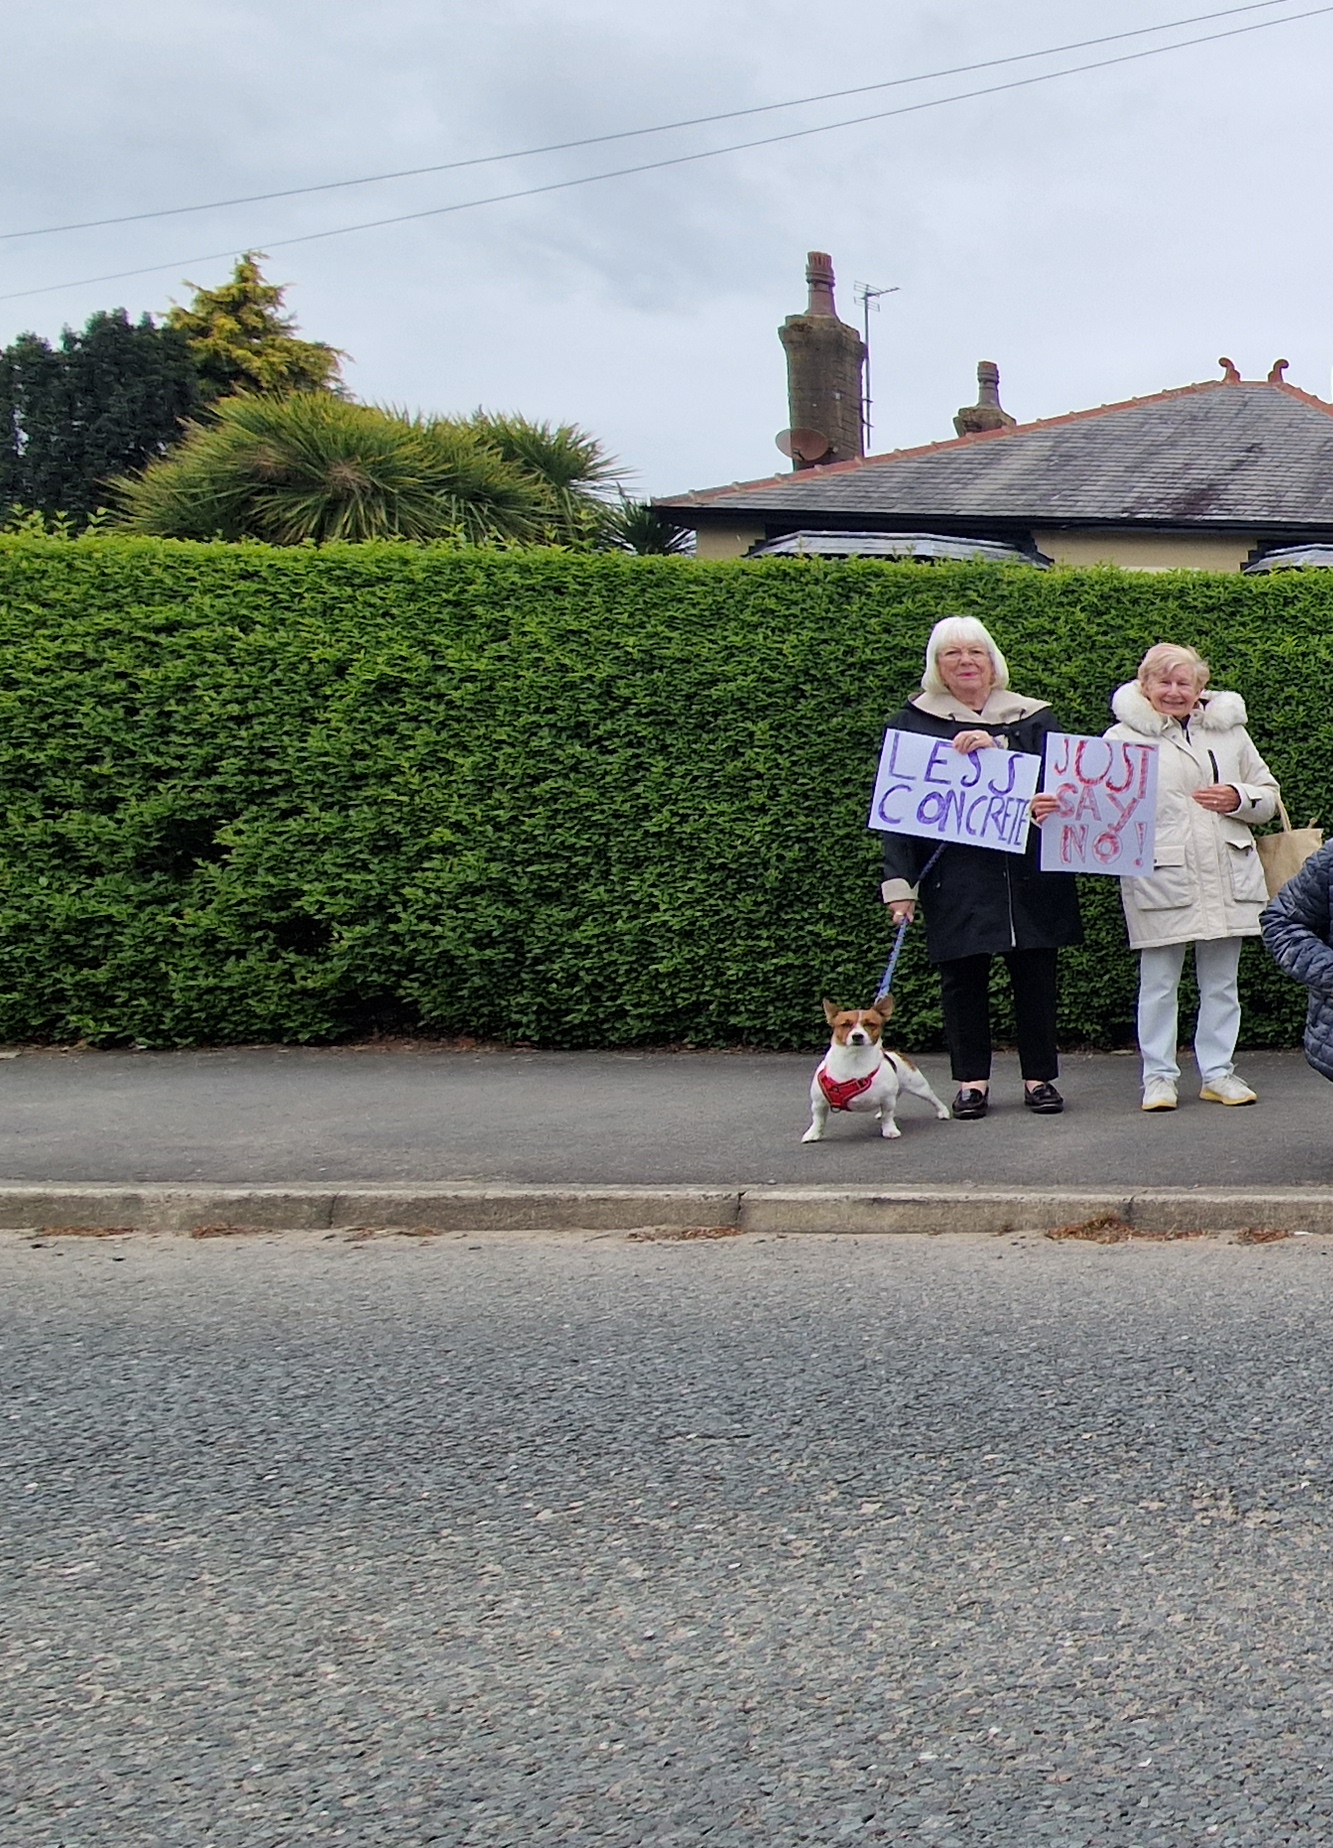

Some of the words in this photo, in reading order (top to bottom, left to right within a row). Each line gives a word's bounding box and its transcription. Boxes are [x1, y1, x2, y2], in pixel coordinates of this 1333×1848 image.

[889, 732, 1025, 796] LESS
[1054, 738, 1156, 799] JUST
[878, 784, 1031, 846] CONCRETE
[1056, 783, 1140, 833] SAY
